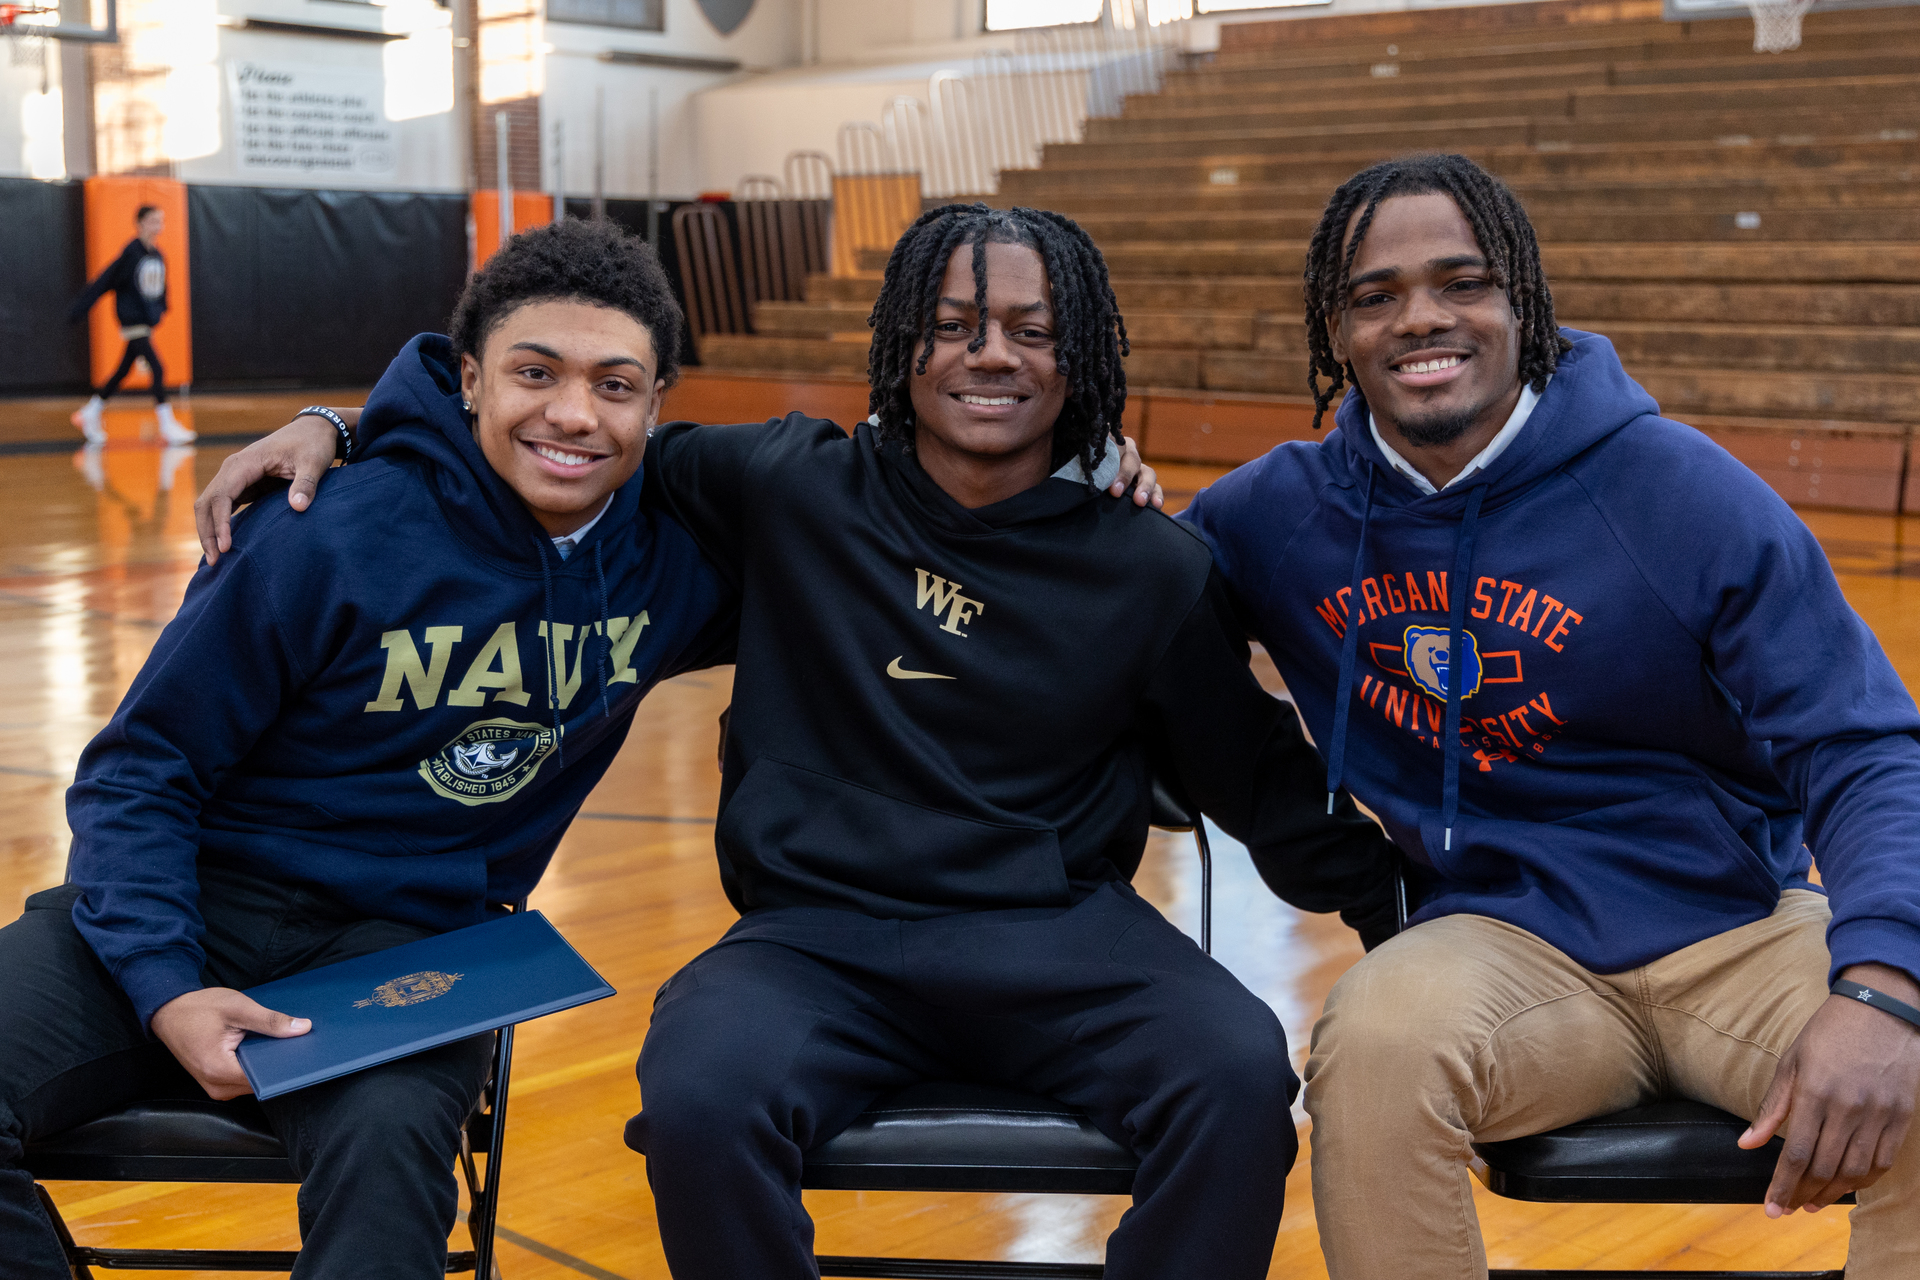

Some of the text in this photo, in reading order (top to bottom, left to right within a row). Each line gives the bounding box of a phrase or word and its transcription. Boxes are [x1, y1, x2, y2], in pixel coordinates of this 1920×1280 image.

[313, 406, 350, 437] FOREST
[914, 567, 985, 638] WF
[1315, 571, 1584, 653] MORGAN STATE
[364, 609, 651, 713] NAVY
[466, 728, 511, 742] STATES
[514, 730, 536, 739] NAV
[534, 731, 552, 757] DEMY
[1360, 674, 1567, 749] UNIVSITY
[432, 762, 516, 794] TABLISHED 1845
